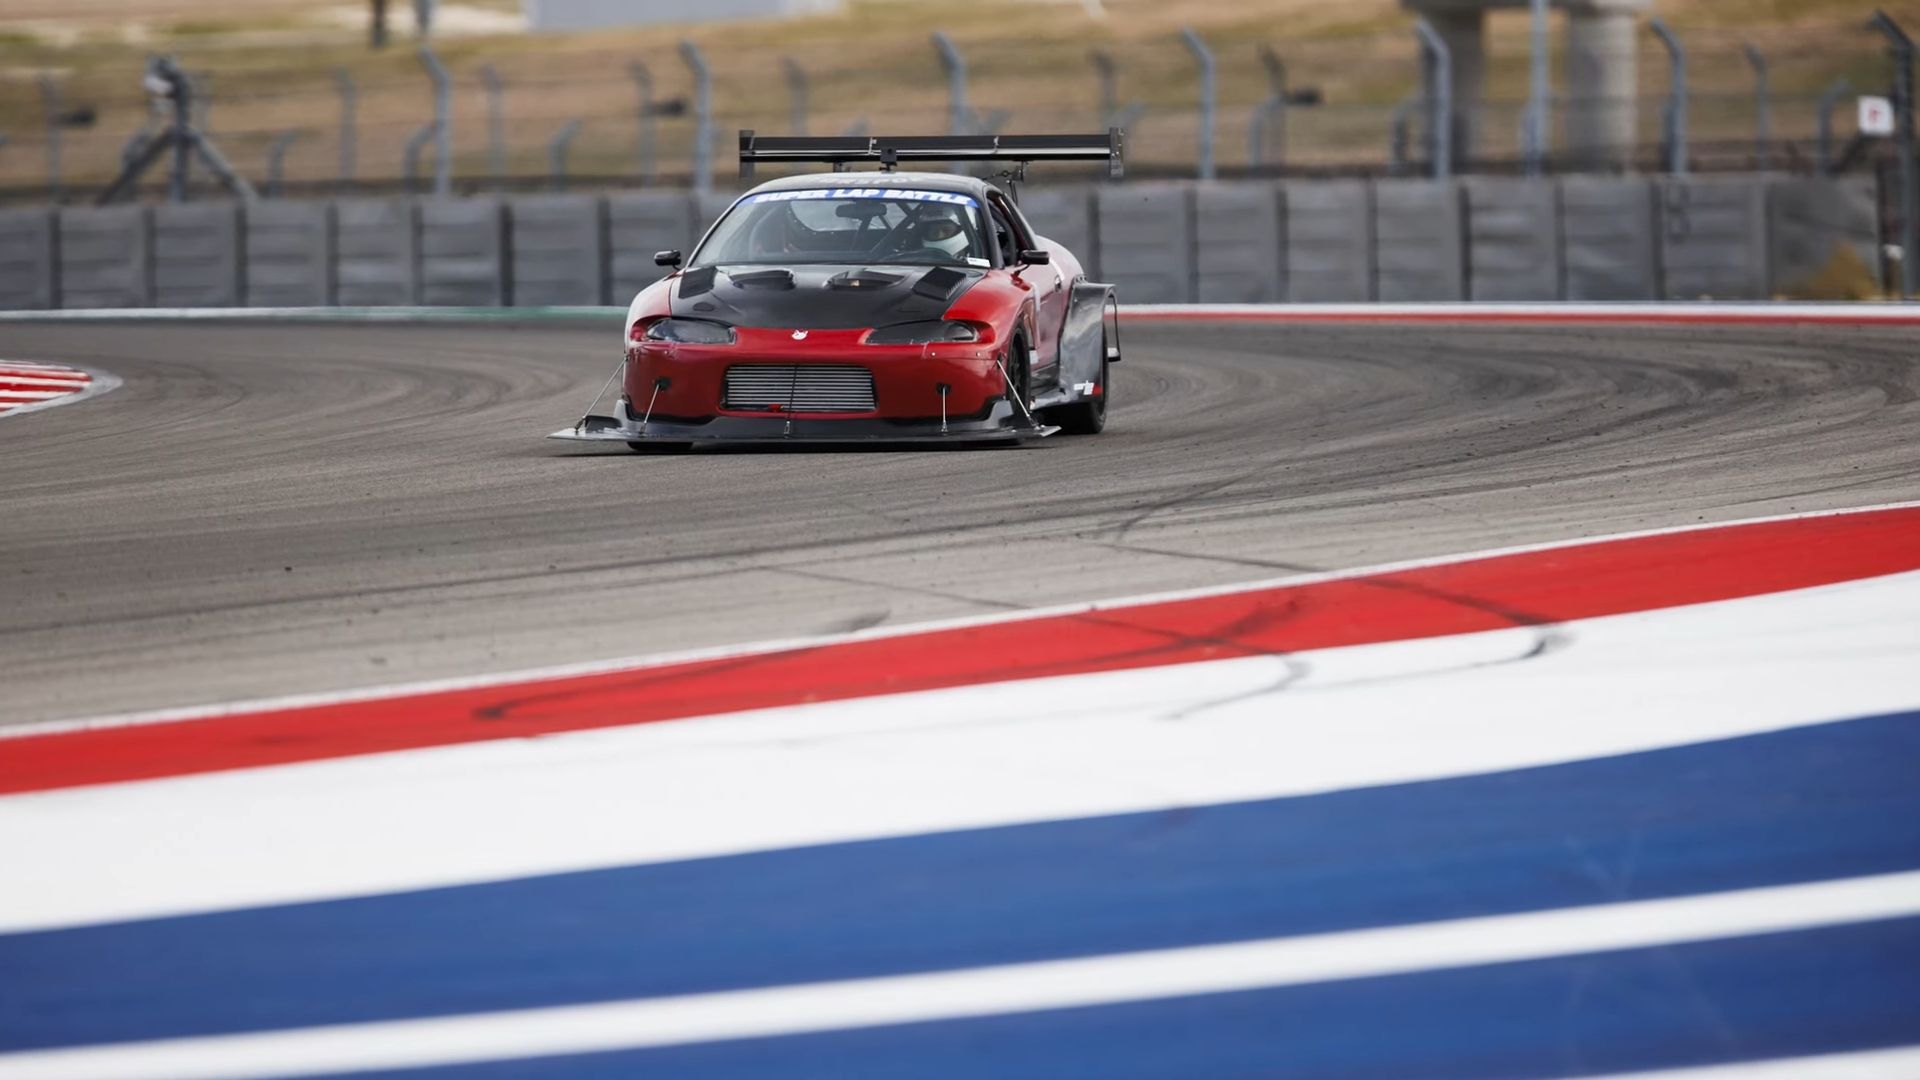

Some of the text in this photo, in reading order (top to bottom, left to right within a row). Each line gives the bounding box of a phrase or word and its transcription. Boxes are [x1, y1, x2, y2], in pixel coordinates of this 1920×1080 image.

[753, 189, 972, 204] SUPER LAP BATTLE
